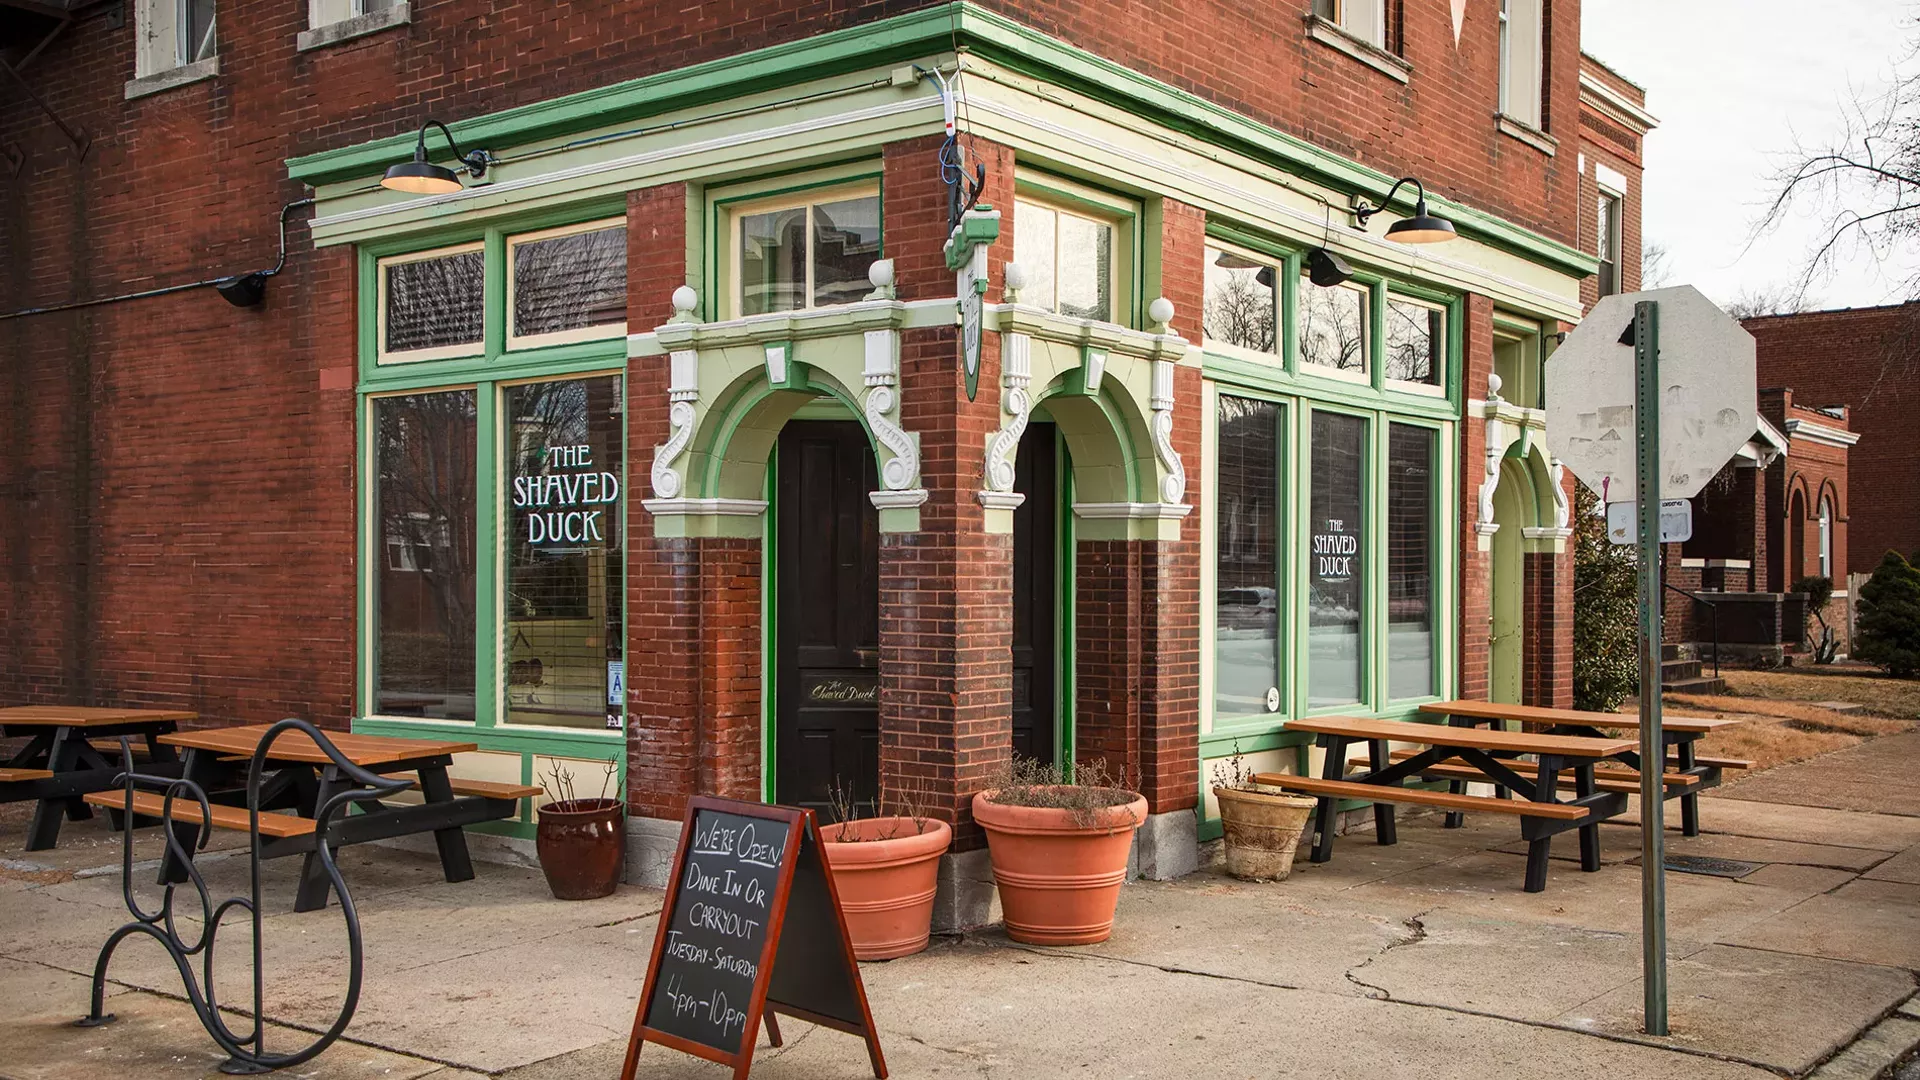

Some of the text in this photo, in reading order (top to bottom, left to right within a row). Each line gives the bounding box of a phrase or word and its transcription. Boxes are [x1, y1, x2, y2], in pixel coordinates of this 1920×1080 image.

[550, 445, 592, 467] THE
[513, 472, 619, 507] SHAVED
[528, 511, 602, 544] DUCK
[1329, 519, 1344, 532] THE
[1313, 535, 1357, 554] SHAVED
[1319, 557, 1351, 575] DUCK
[849, 685, 876, 700] Duck
[686, 863, 765, 907] DINE IN OR
[690, 902, 759, 939] CARRYOUT
